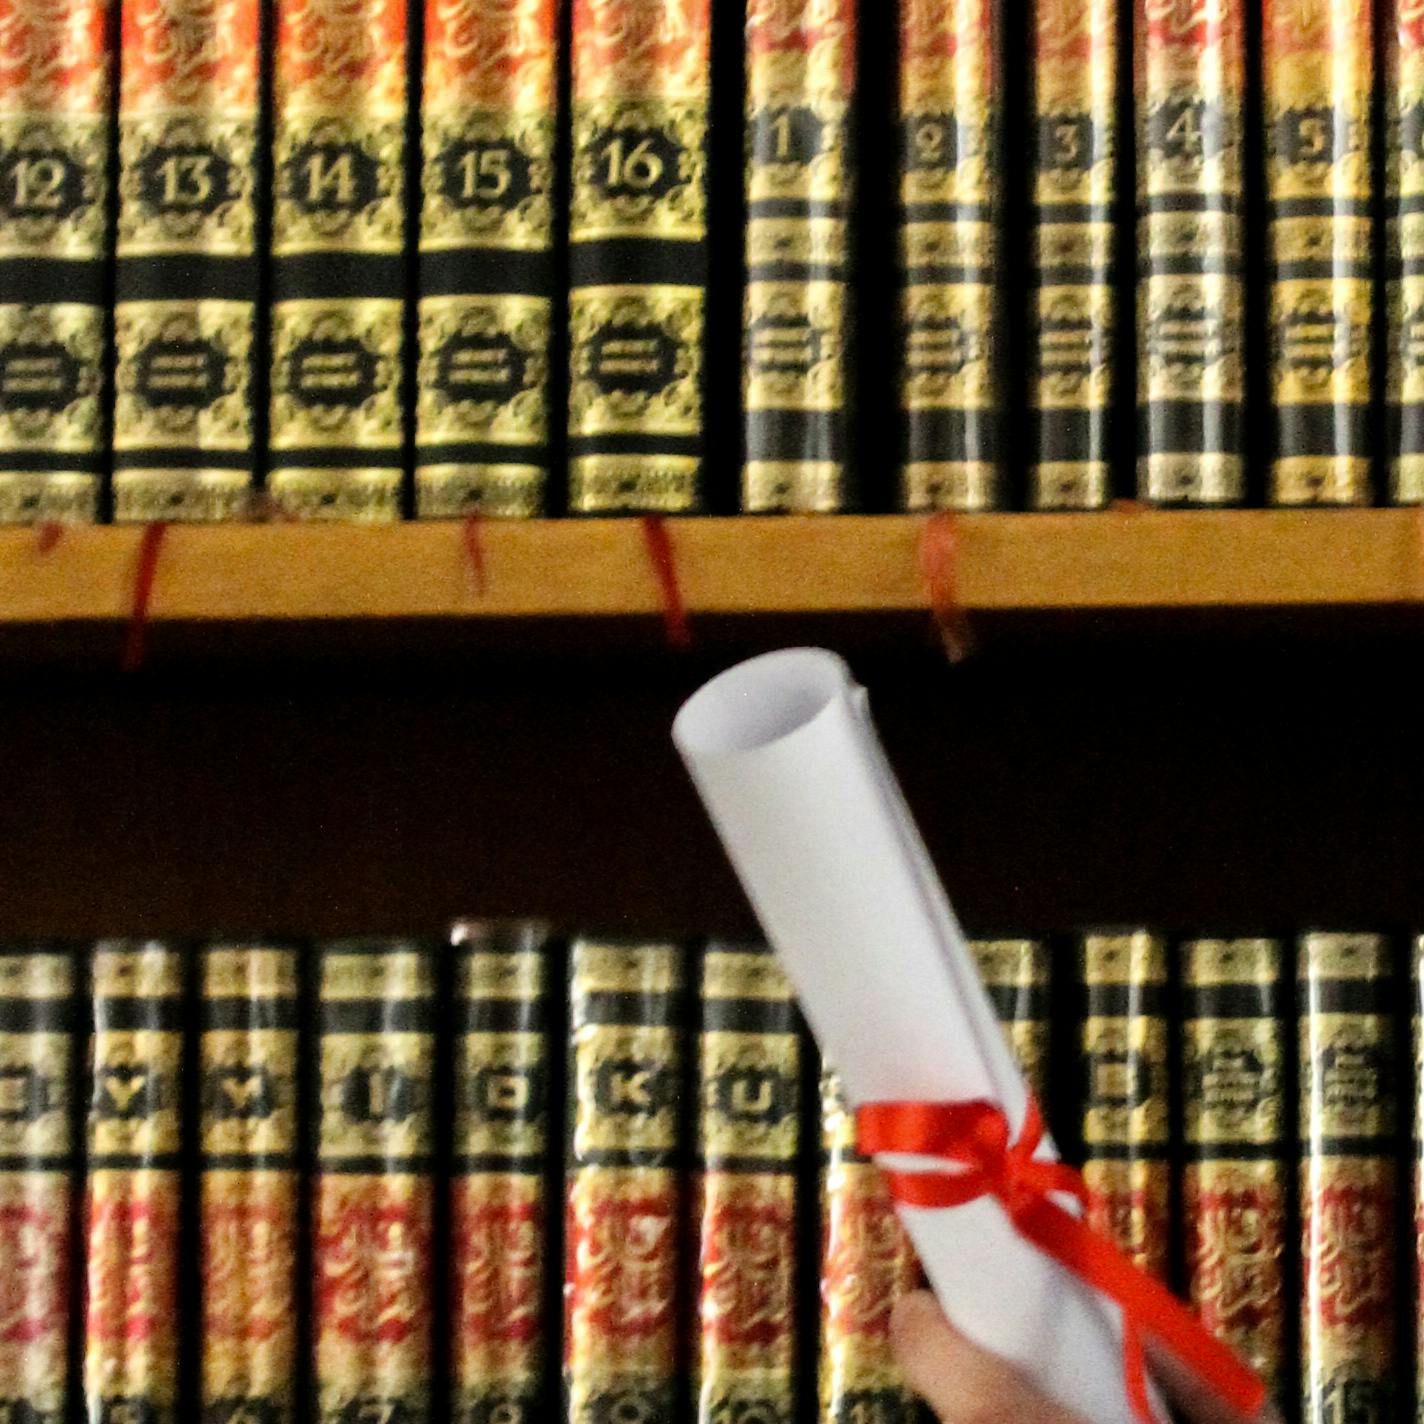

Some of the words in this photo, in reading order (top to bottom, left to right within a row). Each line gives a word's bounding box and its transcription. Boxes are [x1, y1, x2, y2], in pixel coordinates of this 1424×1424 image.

[769, 115, 791, 157] 1
[916, 123, 943, 160] 2
[1055, 122, 1079, 160] 3
[1166, 112, 1200, 150] 4
[1299, 118, 1326, 157] 5
[155, 154, 211, 205] 13
[303, 153, 358, 205] 14
[457, 147, 510, 201] 15
[602, 138, 664, 189] 16
[9, 159, 66, 209] 12
[104, 1076, 146, 1111] Y
[222, 1080, 261, 1111] Y
[610, 1071, 651, 1105] K
[731, 1079, 772, 1112] U
